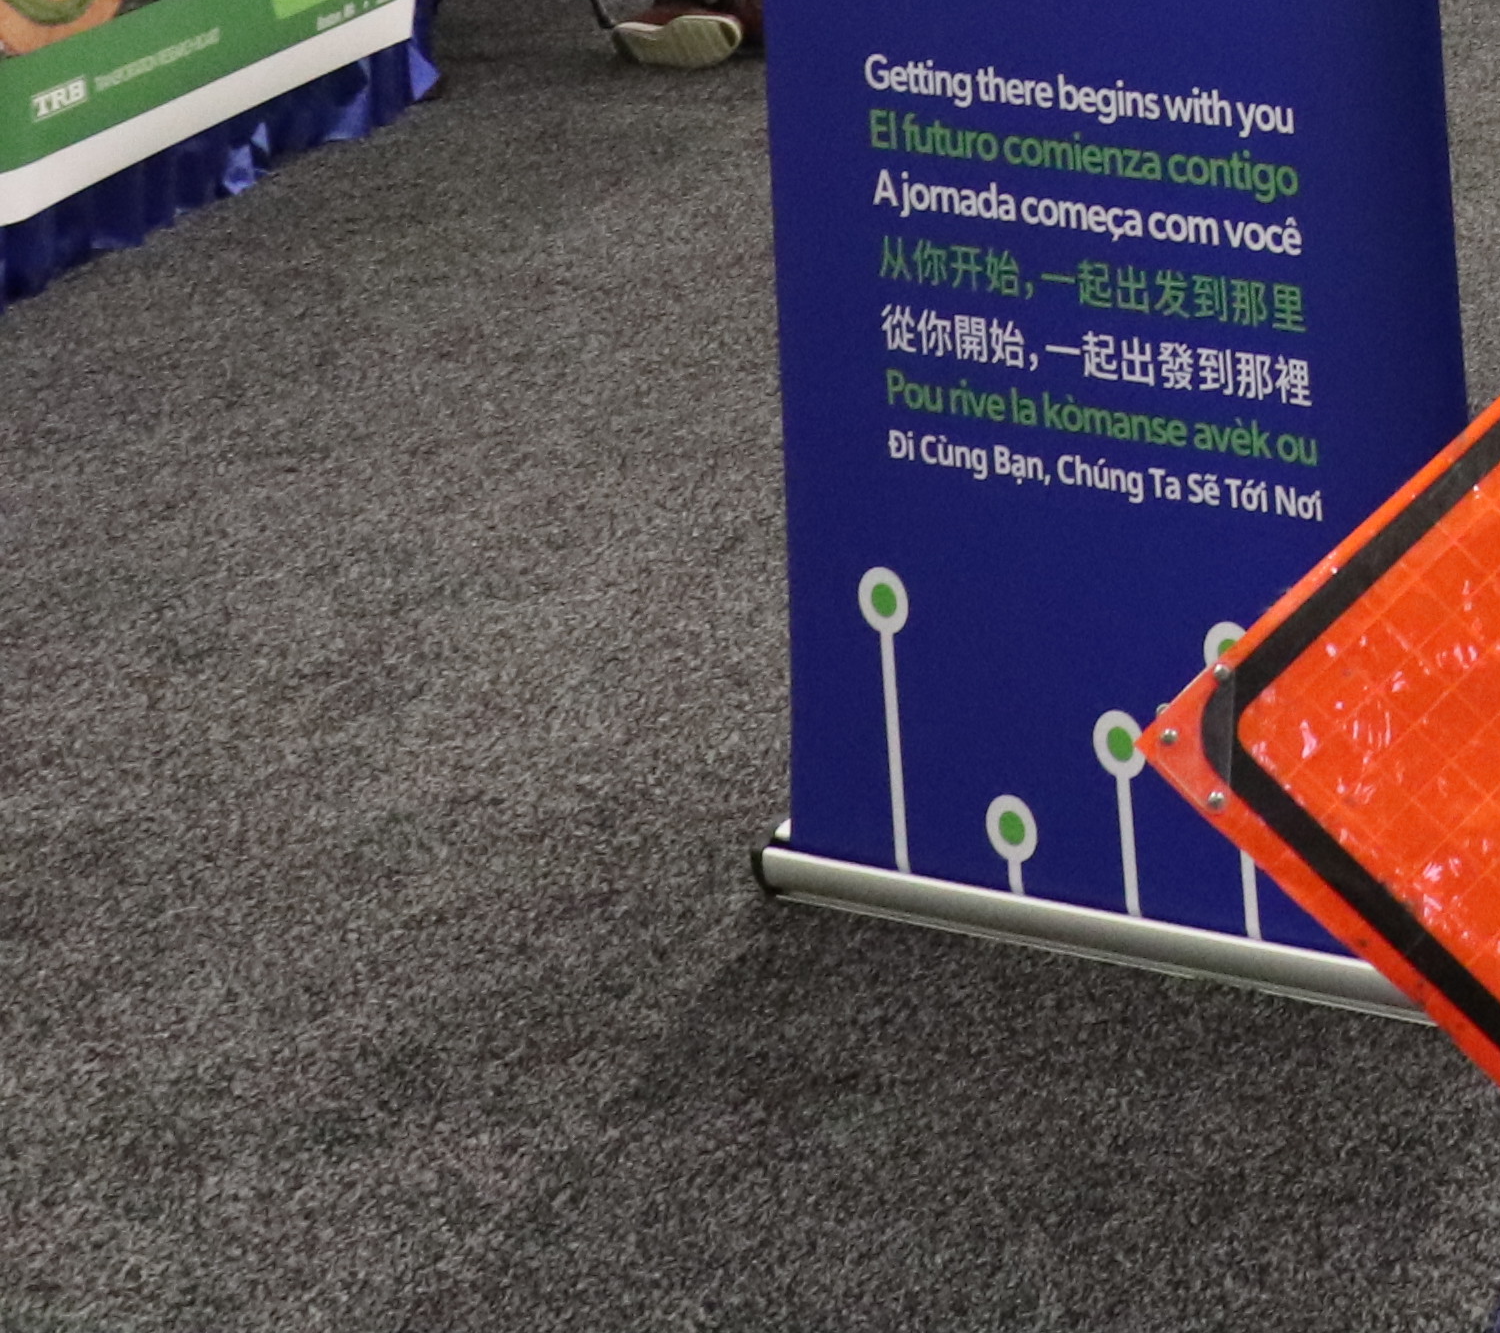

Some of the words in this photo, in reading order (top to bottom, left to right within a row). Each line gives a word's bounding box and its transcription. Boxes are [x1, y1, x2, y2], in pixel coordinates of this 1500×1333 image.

[31, 77, 88, 119] TRB
[864, 53, 974, 109] Getting
[975, 66, 1054, 109] there
[1058, 73, 1161, 124] begins
[1163, 86, 1233, 128] with
[1236, 99, 1294, 139] you
[869, 108, 898, 150] El
[902, 112, 1000, 162] futuro
[1003, 130, 1163, 181] comienza
[1167, 150, 1300, 203] contigo
[872, 168, 899, 208] A
[899, 170, 1018, 223] jornada
[1020, 194, 1143, 244] começa
[1148, 208, 1221, 247] com
[1223, 216, 1303, 256] você
[885, 368, 944, 414] Pou
[949, 377, 1006, 422] rive
[1011, 386, 1038, 428] la
[1042, 391, 1188, 448] kòmanse
[1193, 416, 1273, 460] avèk
[1276, 433, 1319, 467] ou
[888, 428, 916, 461] Đi
[919, 433, 989, 481] Cùng
[993, 444, 1052, 487] Bạn,
[1056, 453, 1144, 505] Chúng
[1148, 467, 1182, 502] Ta
[1186, 473, 1222, 507] Sẽ
[1224, 478, 1270, 514] Tới
[1274, 485, 1324, 522] Nơi
